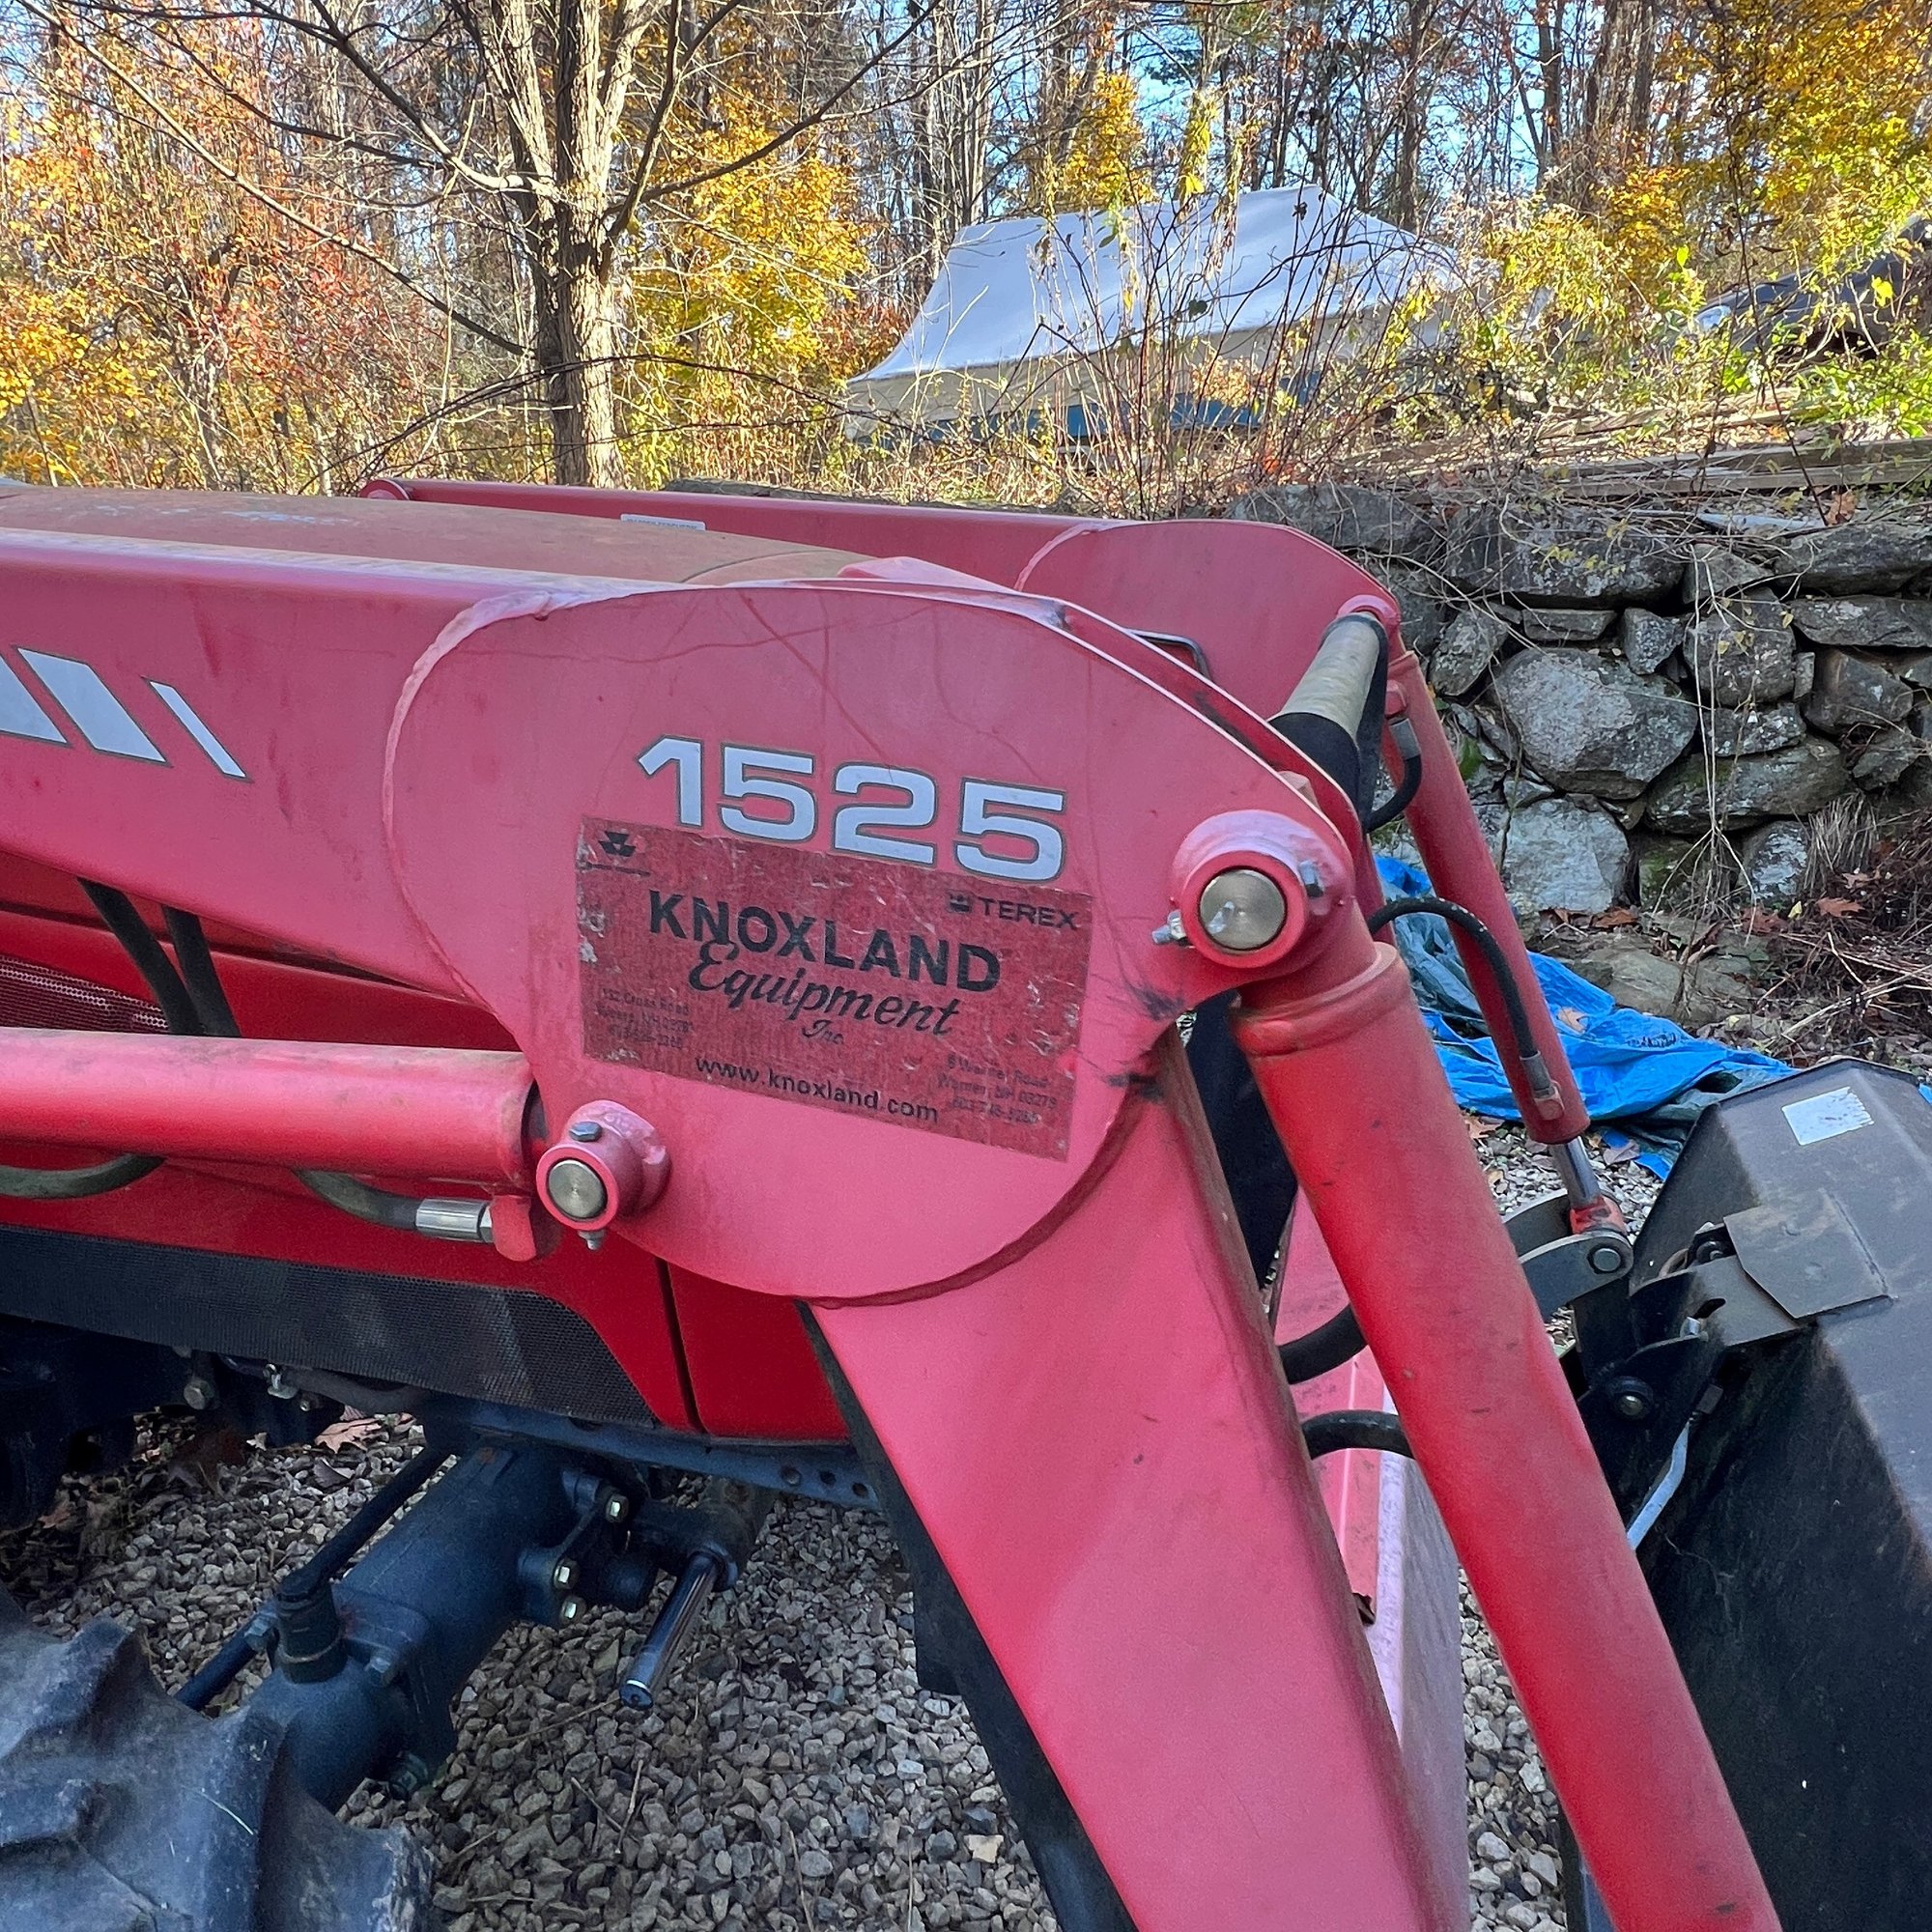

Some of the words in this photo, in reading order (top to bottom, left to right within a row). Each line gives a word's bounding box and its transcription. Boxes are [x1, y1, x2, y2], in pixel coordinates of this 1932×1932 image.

[637, 735, 1066, 882] 1525
[649, 890, 1001, 993] KNOXLAND
[978, 895, 1079, 930] TEREX
[689, 939, 965, 1037] Equipment
[695, 1055, 938, 1124] www.knoxland.com
